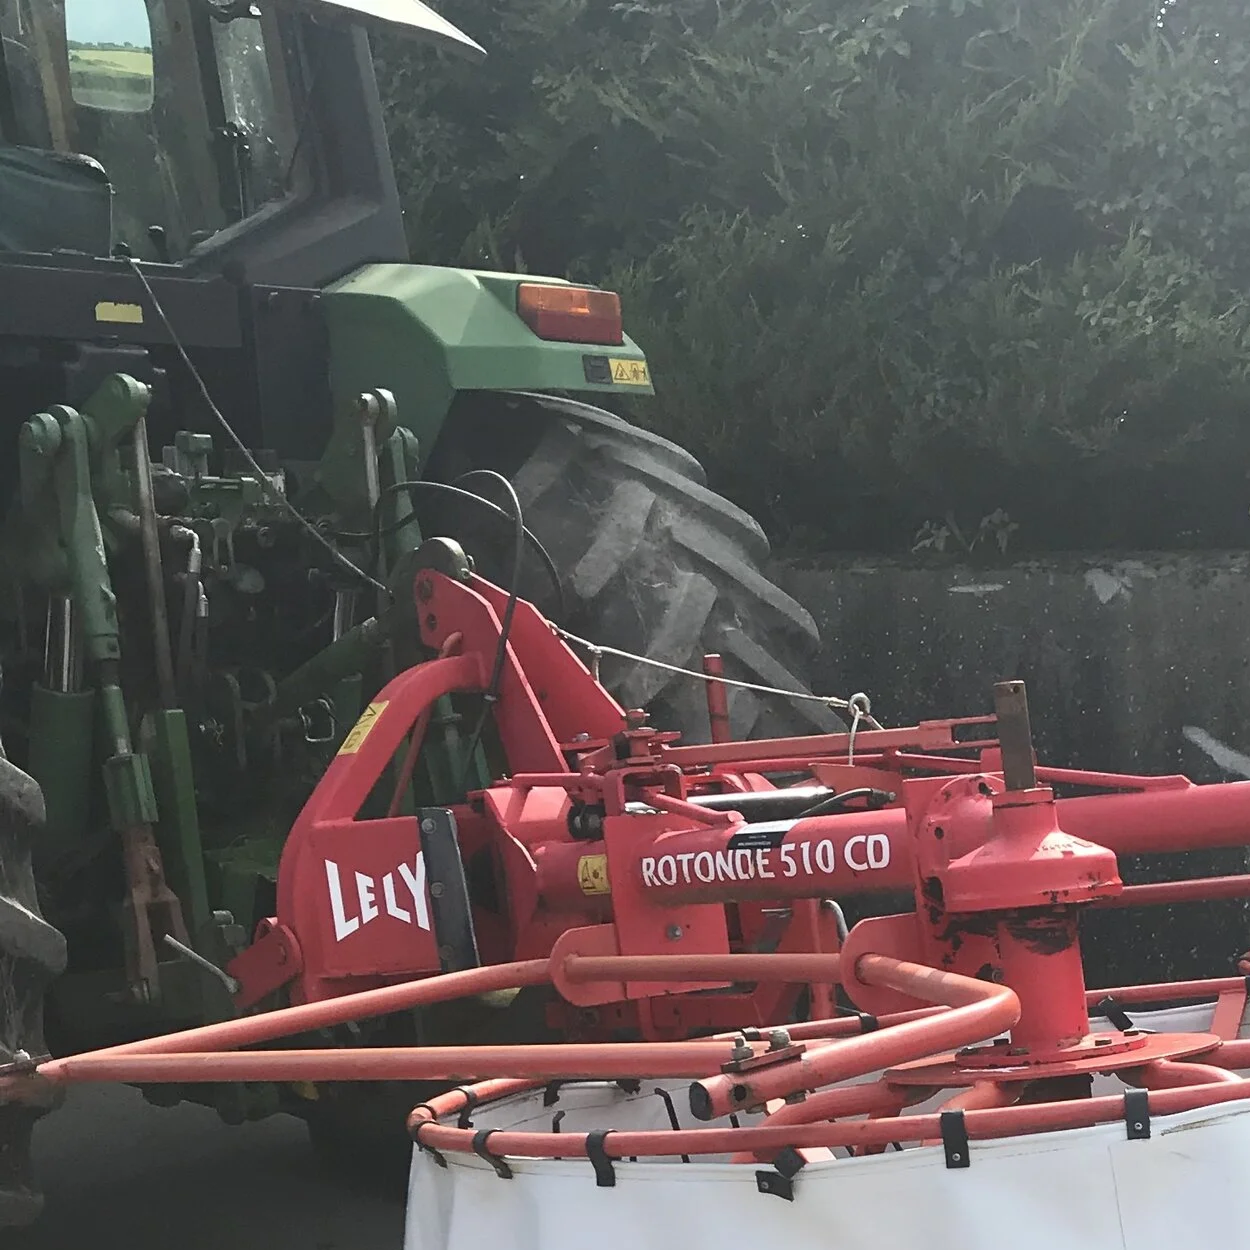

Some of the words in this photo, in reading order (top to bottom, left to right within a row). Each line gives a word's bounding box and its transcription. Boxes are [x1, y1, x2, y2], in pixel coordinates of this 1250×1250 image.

[324, 850, 431, 942] LELY
[641, 847, 776, 887] ROTONDE
[780, 838, 836, 878] 510
[844, 833, 890, 871] CD
